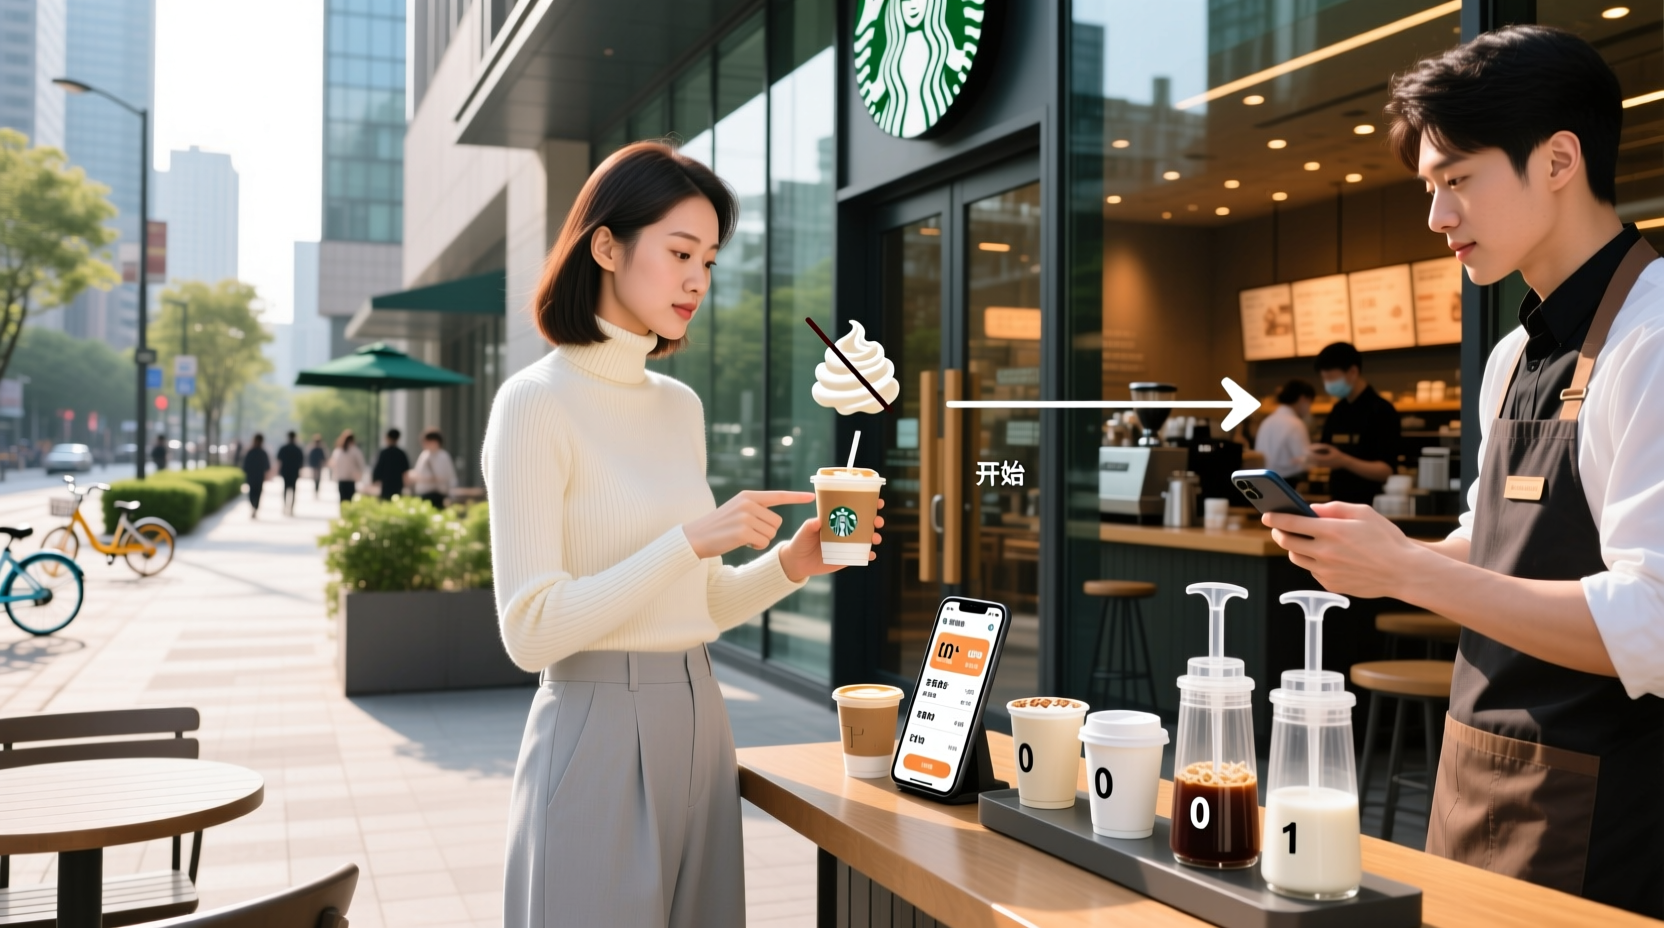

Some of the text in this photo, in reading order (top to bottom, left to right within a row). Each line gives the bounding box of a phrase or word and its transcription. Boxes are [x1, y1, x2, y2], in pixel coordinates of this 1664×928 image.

[1018, 743, 1034, 773] 0
[1094, 767, 1114, 799] 0
[1190, 796, 1210, 829] 0
[1282, 822, 1297, 854] 1
